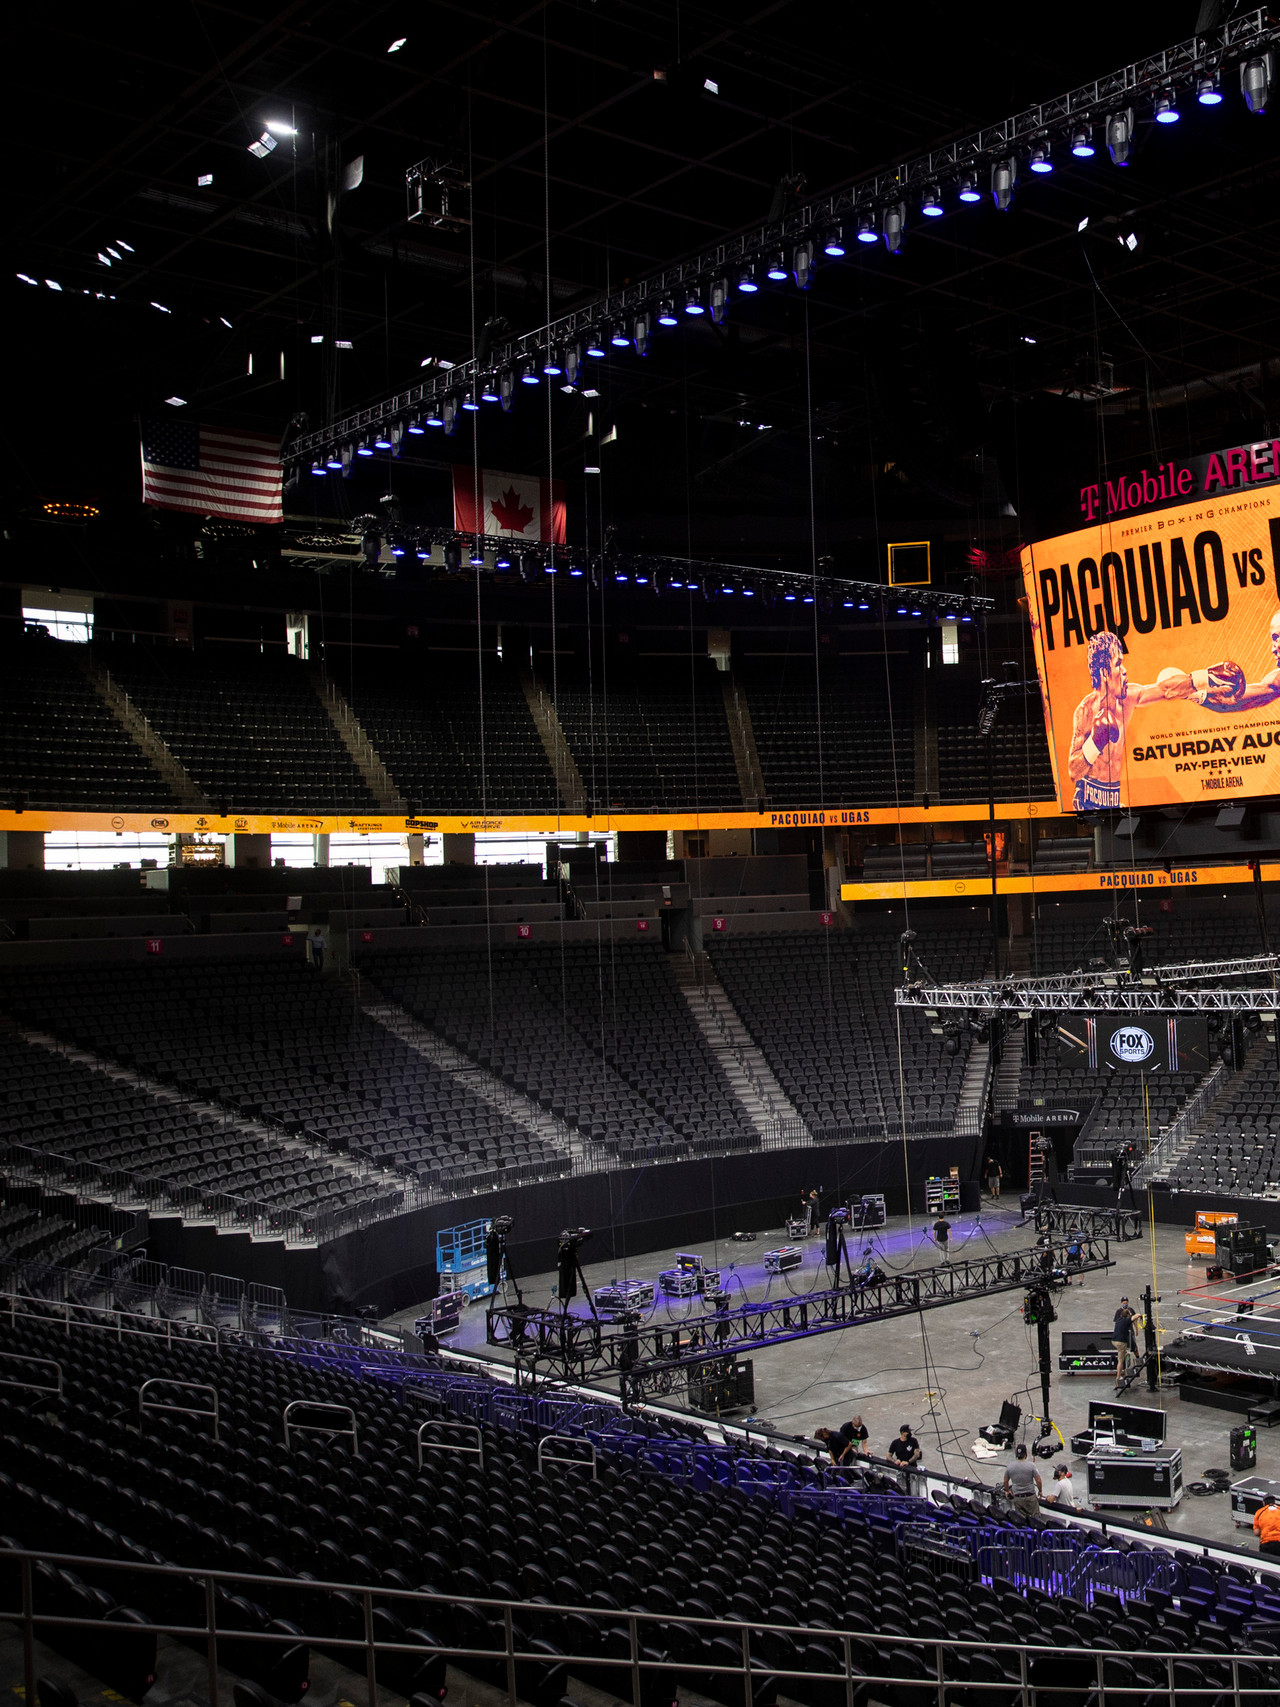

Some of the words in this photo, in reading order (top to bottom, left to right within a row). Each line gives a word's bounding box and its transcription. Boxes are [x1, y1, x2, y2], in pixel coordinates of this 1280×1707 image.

[1121, 524, 1153, 537] PREMIER
[1157, 509, 1215, 529] BOXING
[1218, 498, 1271, 516] CHAMPIONS
[1039, 529, 1229, 655] PACQUIAO
[1232, 547, 1265, 589] VS
[1175, 725, 1231, 737] WELTERWEIGHT
[1132, 736, 1238, 762] SATURDAY
[1175, 754, 1266, 773] PAY-PER-VIEW
[1226, 775, 1243, 788] ARENA
[771, 811, 825, 827] PACQUIAO
[841, 811, 869, 823] UGAS
[1100, 873, 1154, 888] PACQUIAO
[1170, 871, 1198, 884] UGAS
[716, 920, 722, 929] 9
[824, 914, 830, 923] 9
[520, 927, 529, 936] 10
[151, 941, 160, 952] 11
[1119, 1033, 1143, 1048] FOX
[1119, 1047, 1145, 1056] SPORTS
